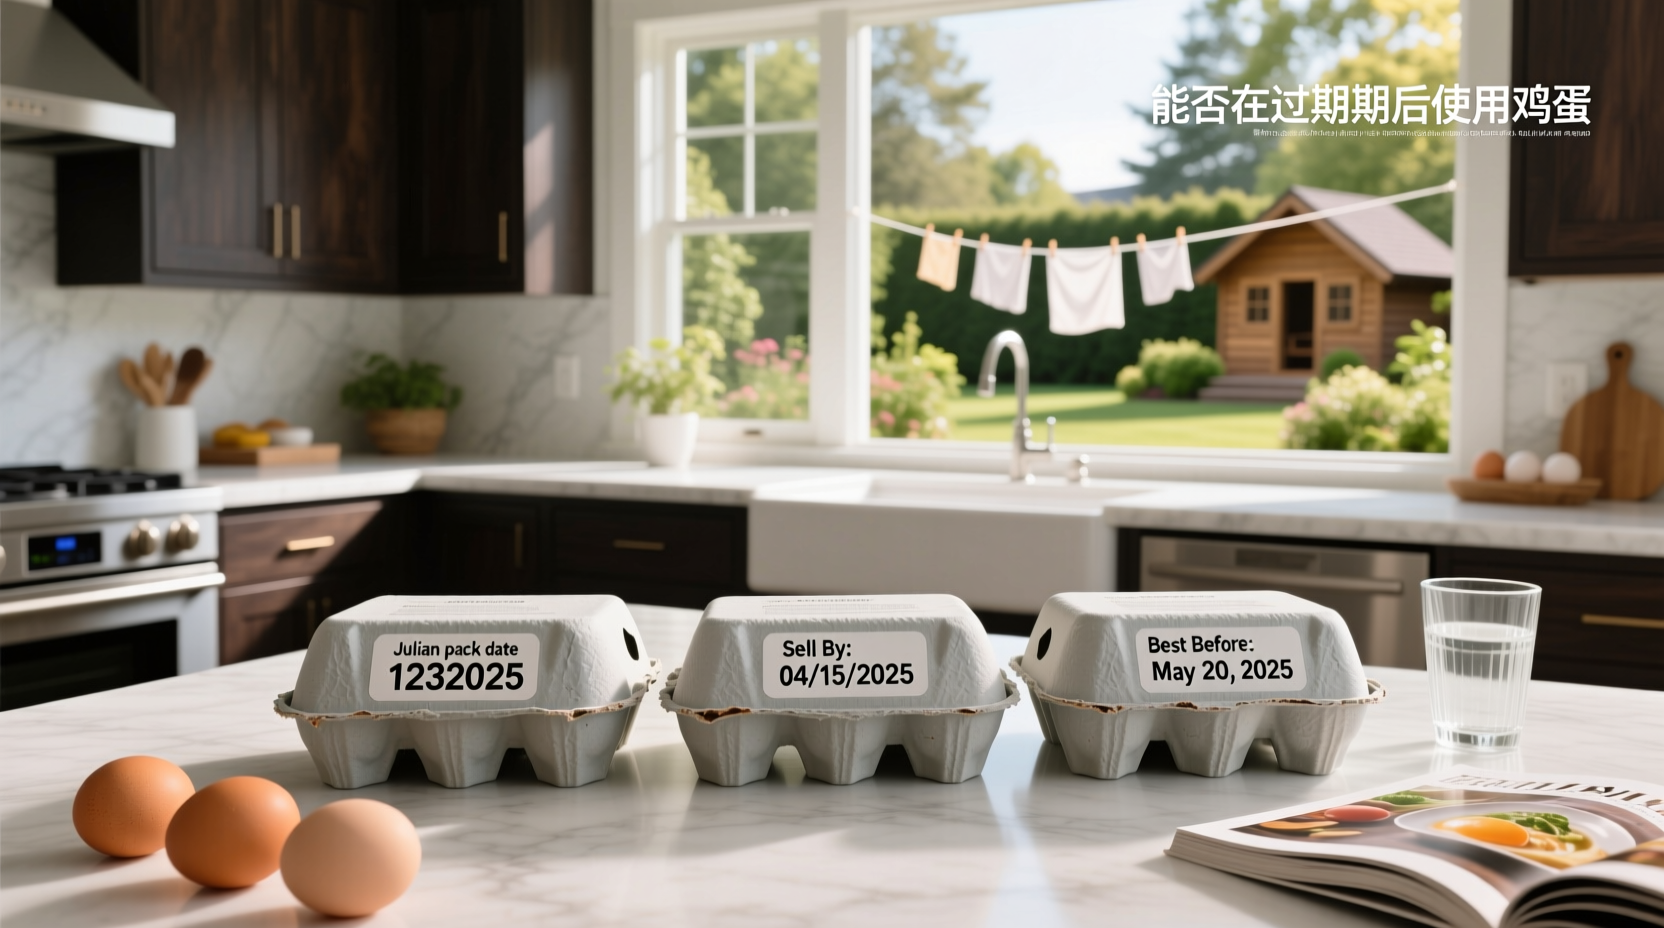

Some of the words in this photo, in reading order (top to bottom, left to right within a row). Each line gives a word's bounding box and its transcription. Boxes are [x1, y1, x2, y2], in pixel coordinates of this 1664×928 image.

[393, 640, 440, 657] Julian
[444, 640, 481, 661] pack
[484, 640, 519, 657] date
[782, 639, 817, 658] Sell
[822, 639, 852, 661] By:
[1147, 636, 1187, 654] Best
[1191, 634, 1255, 653] Before:
[389, 662, 524, 691] 1232025
[779, 662, 914, 689] 04/15/2025
[1151, 660, 1196, 687] May
[1201, 659, 1236, 685] 20,
[1240, 658, 1294, 680] 2025
